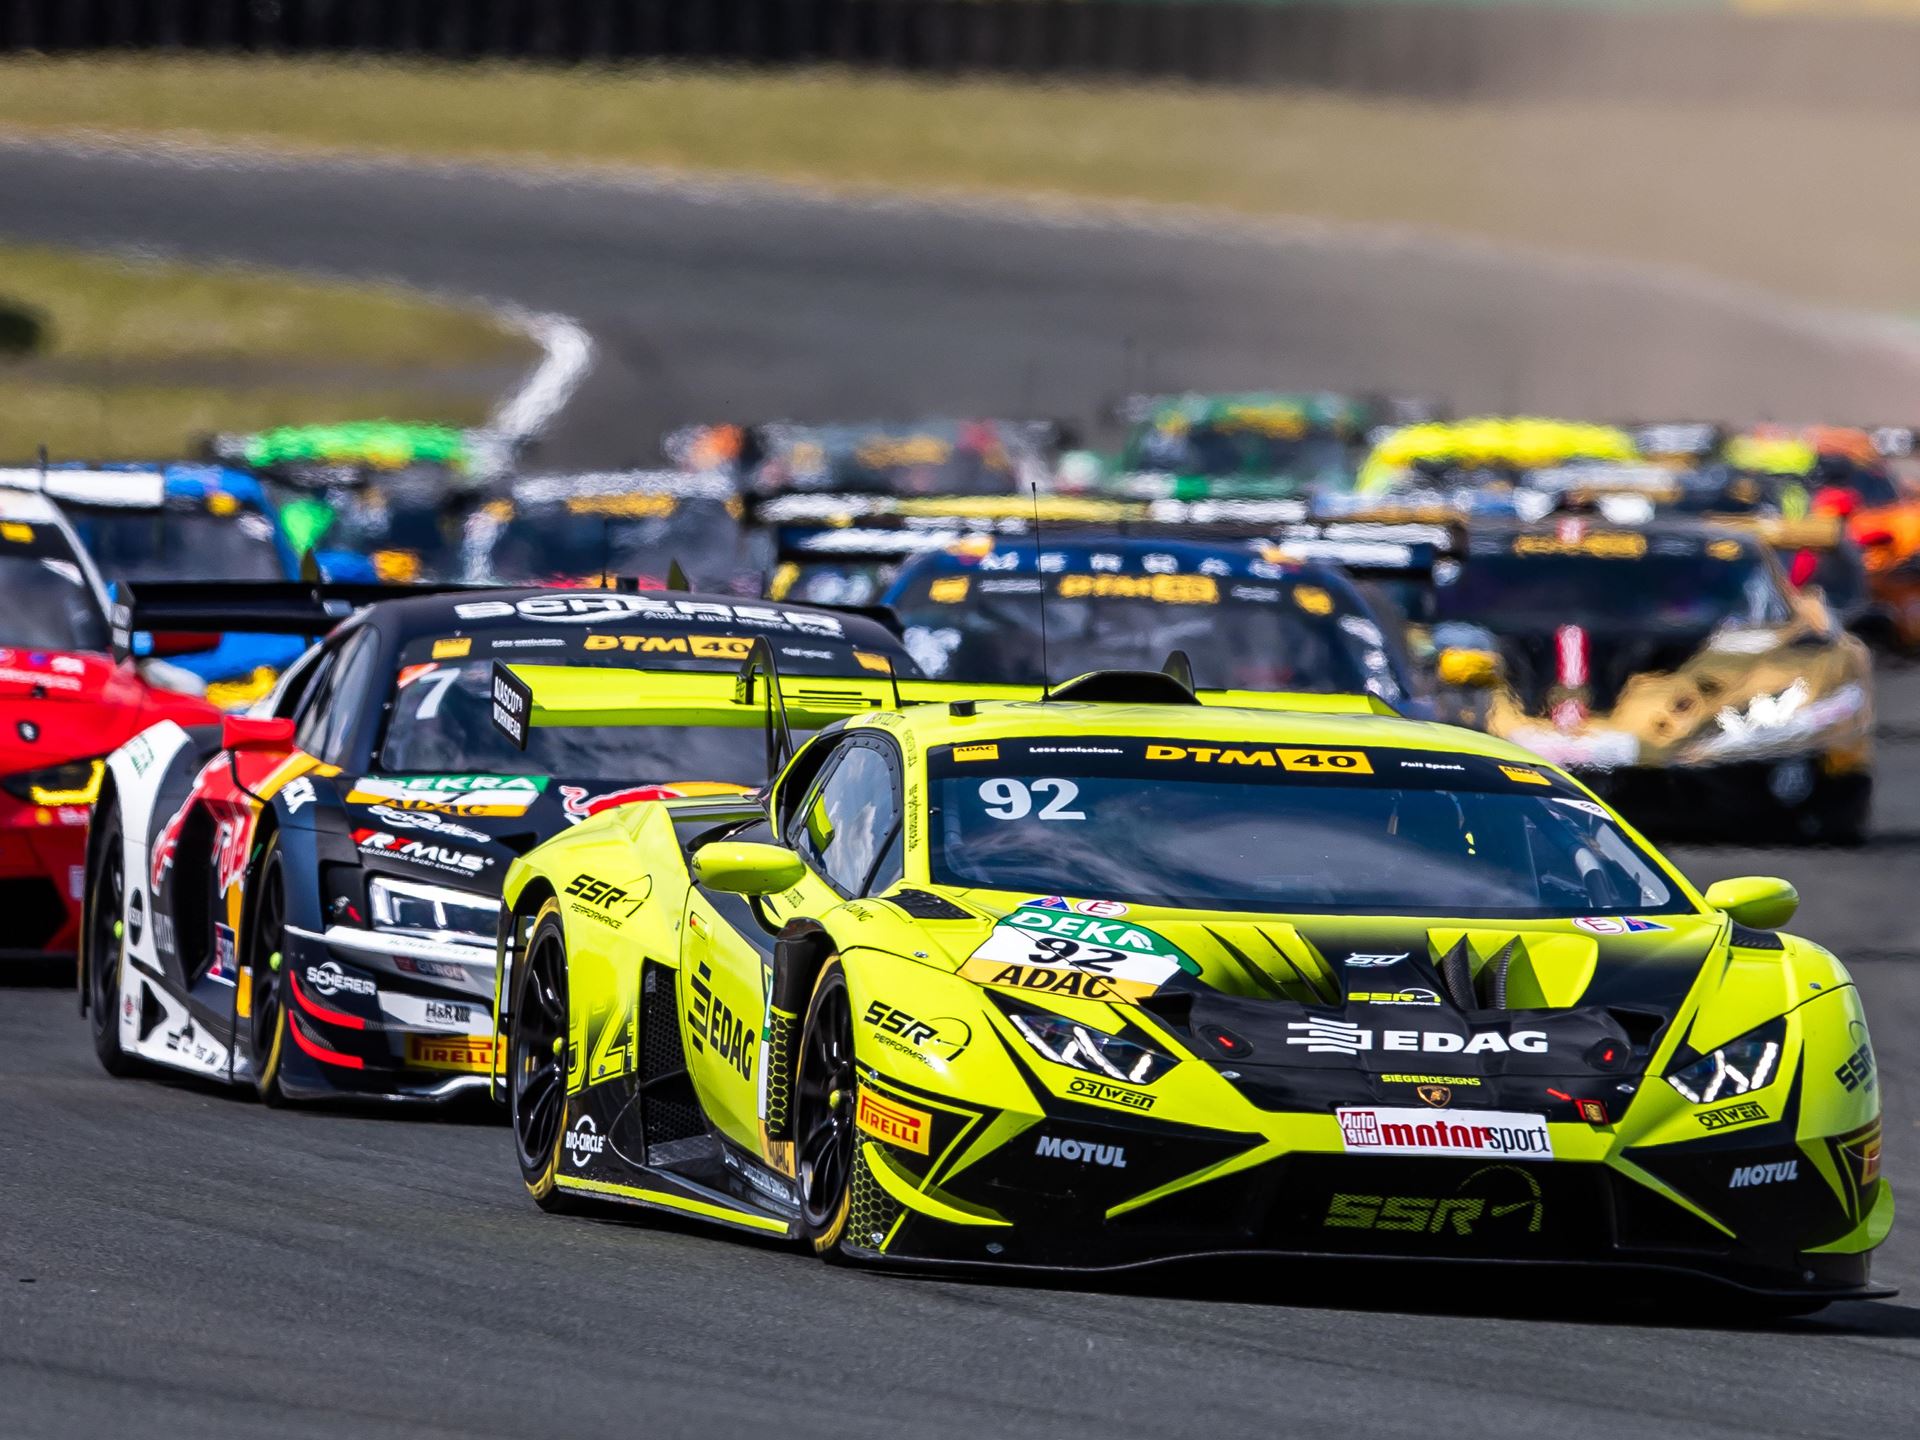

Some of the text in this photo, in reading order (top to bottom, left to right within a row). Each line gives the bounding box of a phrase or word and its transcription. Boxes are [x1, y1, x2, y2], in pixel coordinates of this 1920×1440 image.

[583, 635, 688, 652] DTM
[415, 667, 461, 720] 7
[956, 745, 995, 753] ADAC
[1145, 745, 1357, 768] DTM 40
[978, 778, 1087, 820] 92
[564, 874, 628, 909] SSR
[569, 902, 623, 929] PERFORMANCE
[1028, 937, 1128, 972] 92
[990, 964, 1117, 998] ADAC
[1348, 992, 1415, 1001] SSR
[709, 996, 756, 1082] EDAG
[863, 1000, 940, 1046] SSR
[873, 1032, 936, 1070] PERFORMAN
[1383, 1031, 1549, 1053] EDAG
[1380, 1074, 1481, 1086] SIEGERDESIGNS
[859, 1094, 921, 1144] PIRELLI
[1341, 1112, 1375, 1129] Auto
[1035, 1136, 1127, 1168] MOTUL
[1344, 1129, 1379, 1145] Bild
[1729, 1160, 1798, 1188] MOTUL
[1324, 1193, 1486, 1235] SSR
